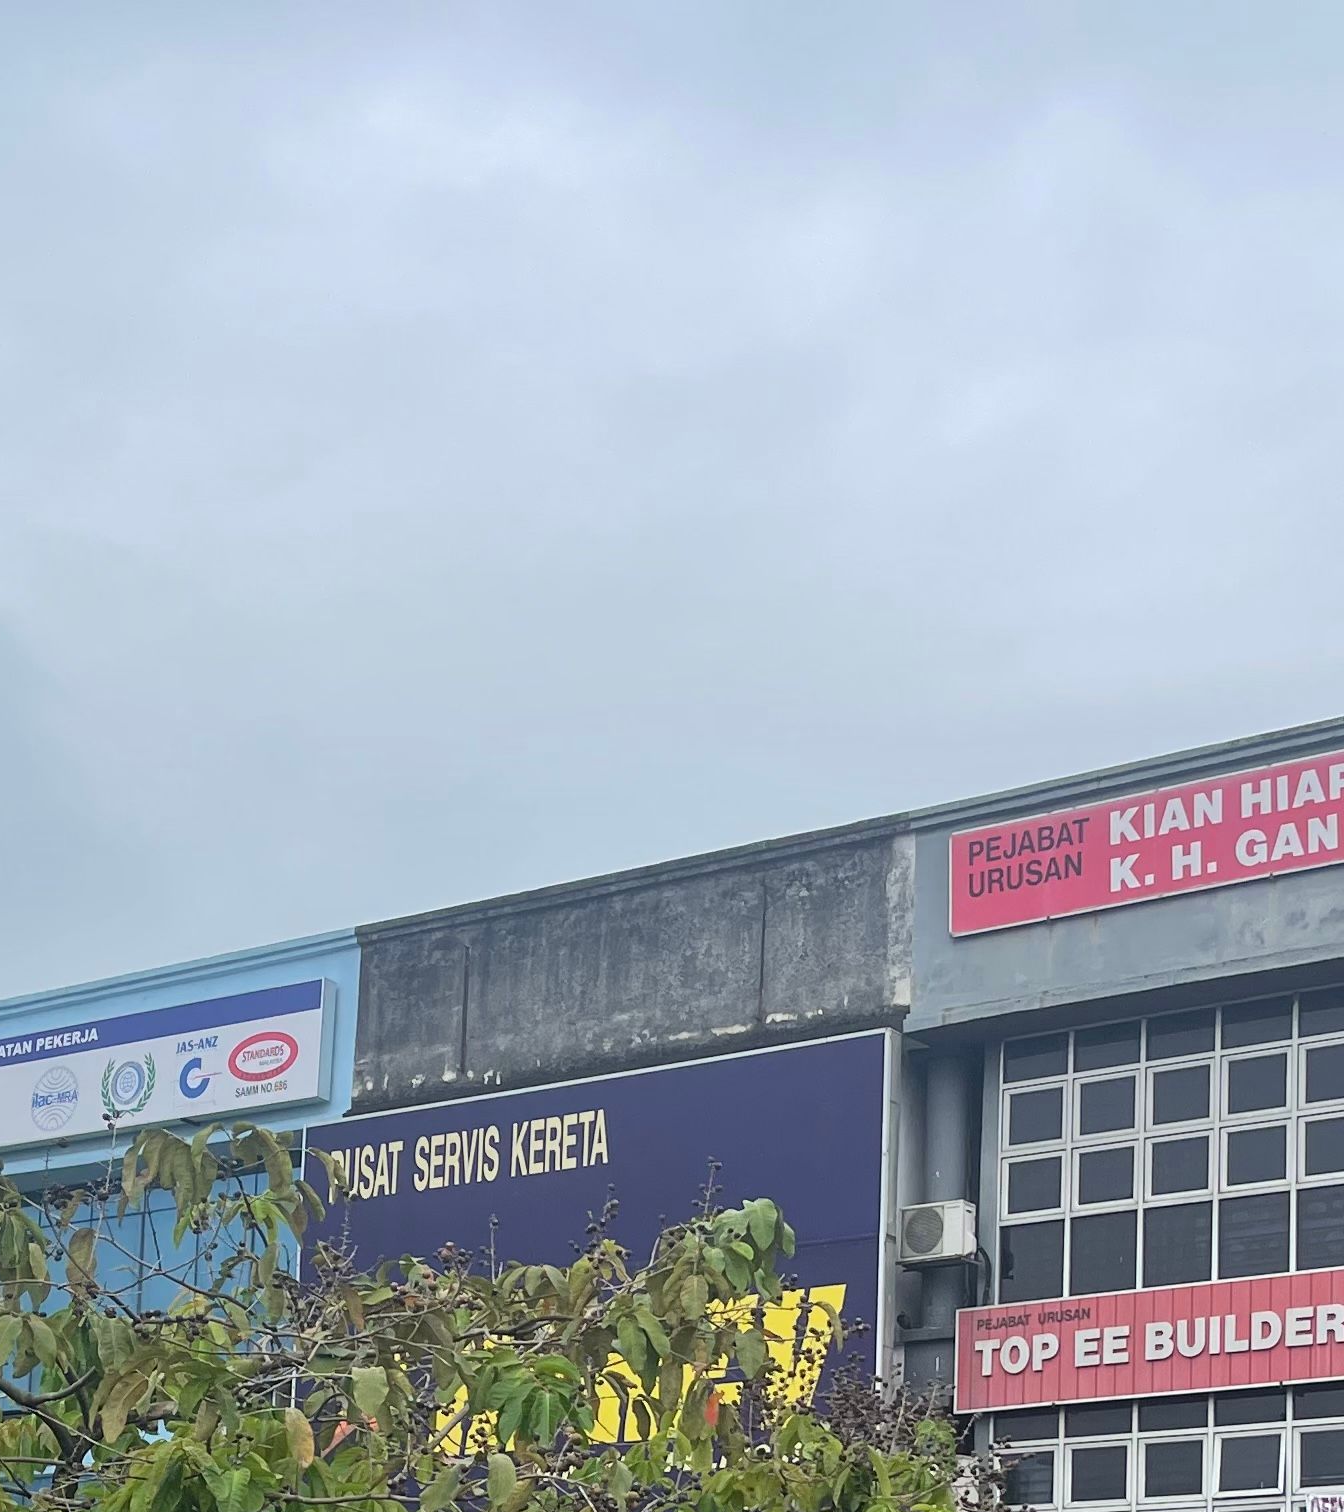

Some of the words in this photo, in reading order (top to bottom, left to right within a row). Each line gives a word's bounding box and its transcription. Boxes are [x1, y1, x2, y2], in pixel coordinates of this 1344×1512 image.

[968, 818, 1090, 867] PEJABAT
[1109, 789, 1223, 846] KIAN
[969, 854, 1083, 898] URUSAN
[1109, 856, 1155, 893] K.
[1171, 841, 1217, 879] H.
[1235, 814, 1339, 865] GAN
[35, 1028, 99, 1052] PEKERJA
[176, 1036, 218, 1054] JAS-ANZ
[235, 1084, 259, 1098] SAMM
[413, 1124, 500, 1193] SERVIS
[510, 1108, 609, 1178] KERETA
[976, 1313, 1032, 1330] PEJABAT
[1037, 1306, 1091, 1326] URUSAN
[975, 1333, 1060, 1378] TOP
[1073, 1325, 1130, 1366] EE
